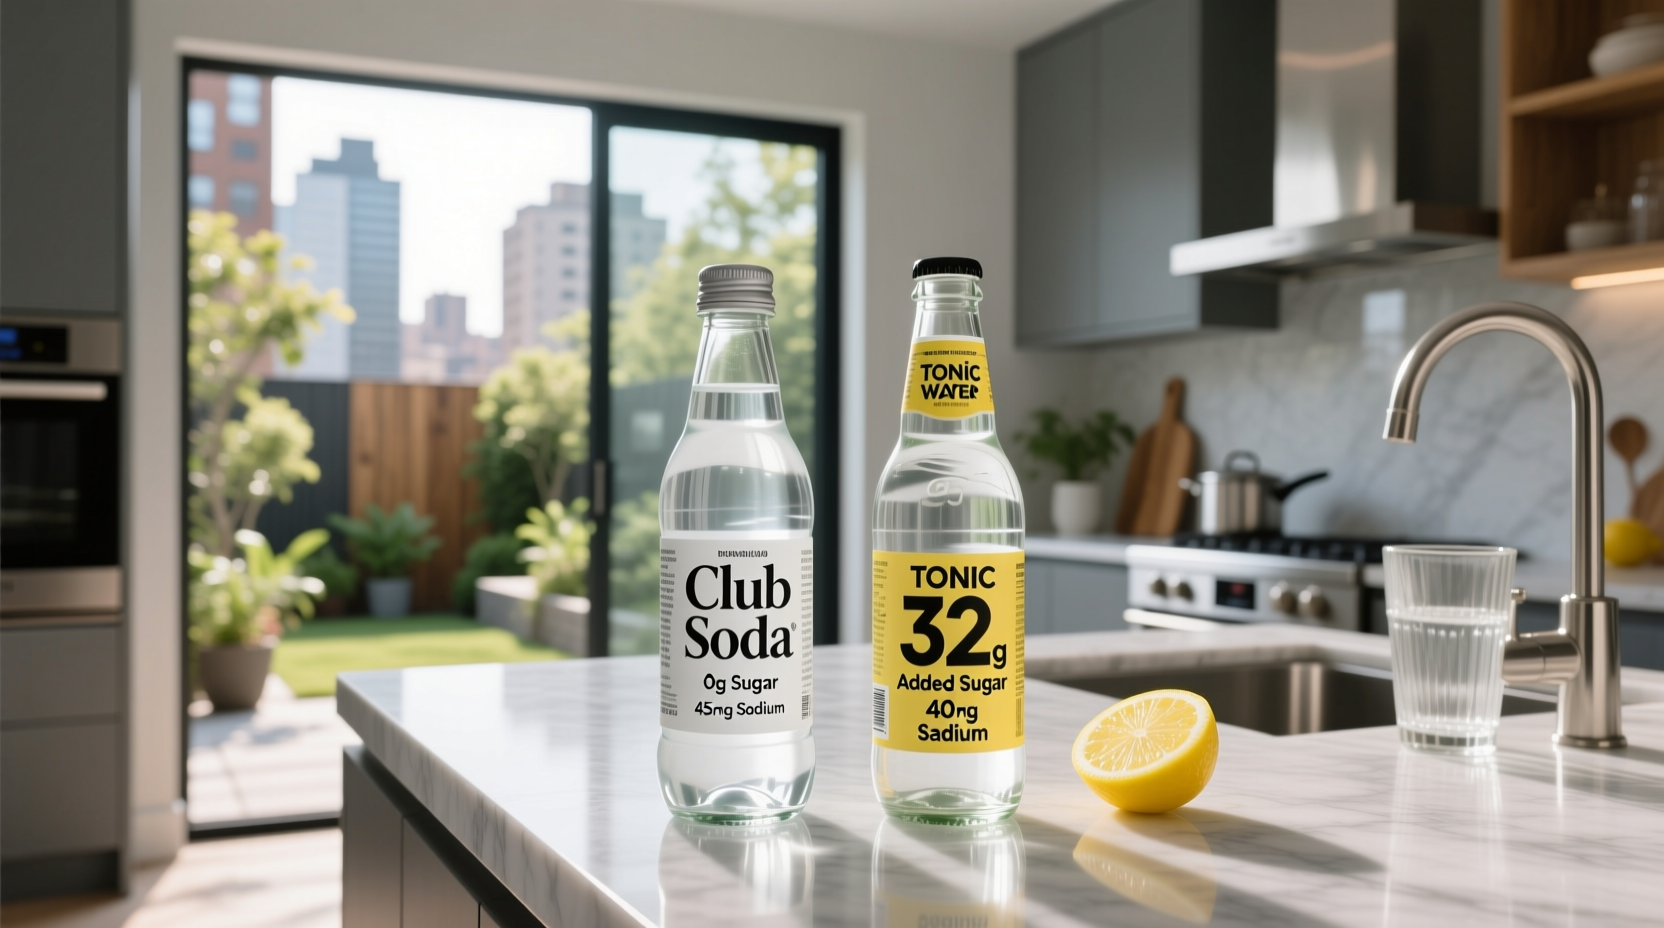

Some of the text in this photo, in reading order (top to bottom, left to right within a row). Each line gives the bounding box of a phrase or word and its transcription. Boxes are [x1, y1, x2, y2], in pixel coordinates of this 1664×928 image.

[685, 563, 792, 610] Club
[910, 565, 996, 589] TONIC
[685, 614, 794, 660] Soda
[900, 595, 1007, 669] 32g
[703, 673, 779, 695] 0g Sugar
[897, 673, 1008, 696] Added Sugar
[736, 701, 785, 716] Sodium
